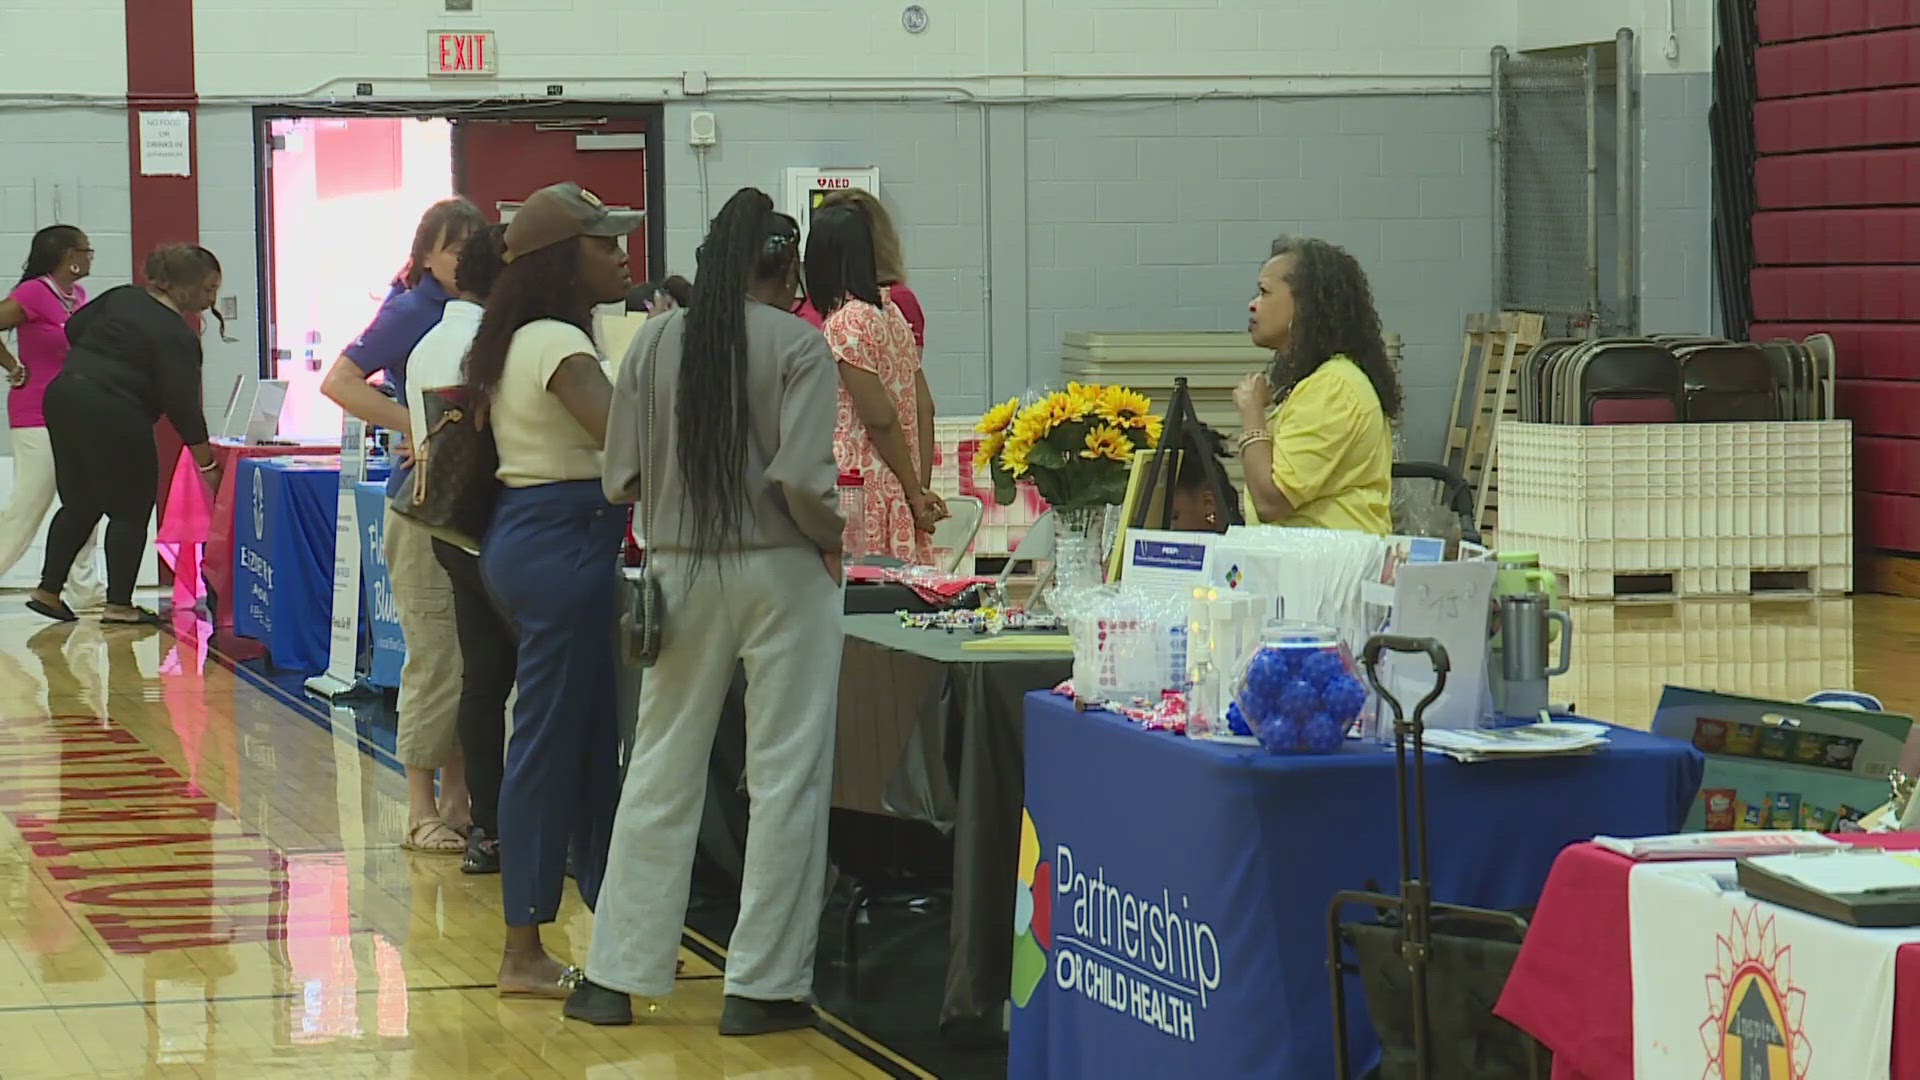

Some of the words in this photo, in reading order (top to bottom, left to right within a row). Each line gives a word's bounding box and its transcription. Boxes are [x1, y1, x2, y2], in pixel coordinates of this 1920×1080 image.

[439, 35, 485, 71] EXIT
[828, 178, 850, 188] AED
[1057, 845, 1221, 1009] Partnership
[1056, 949, 1083, 993] OR
[1085, 959, 1127, 1012] CHILD
[1130, 978, 1195, 1042] HEALTH
[1735, 1009, 1779, 1048] Inspire
